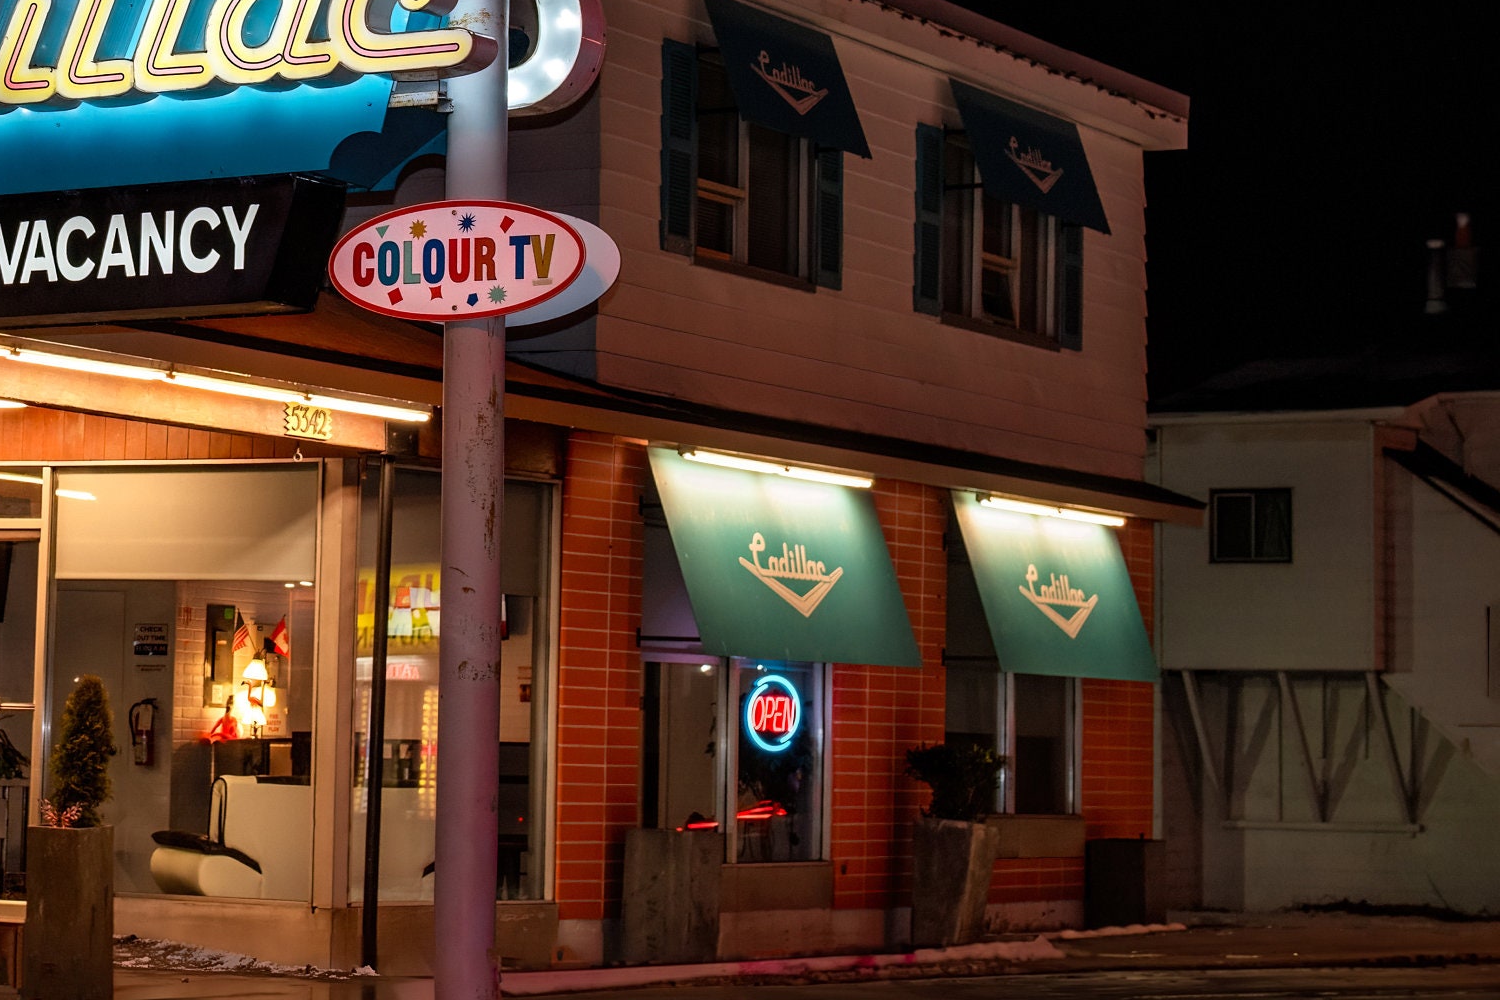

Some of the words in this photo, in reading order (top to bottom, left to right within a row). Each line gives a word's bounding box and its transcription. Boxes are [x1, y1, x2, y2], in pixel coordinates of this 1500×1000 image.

[757, 49, 819, 97] Cadillac
[352, 236, 497, 288] COLOUR
[509, 233, 556, 280] TV
[291, 404, 327, 437] 5342
[748, 532, 831, 583] Cadillac
[1025, 563, 1090, 609] Cadillac
[752, 696, 797, 732] OPEN
